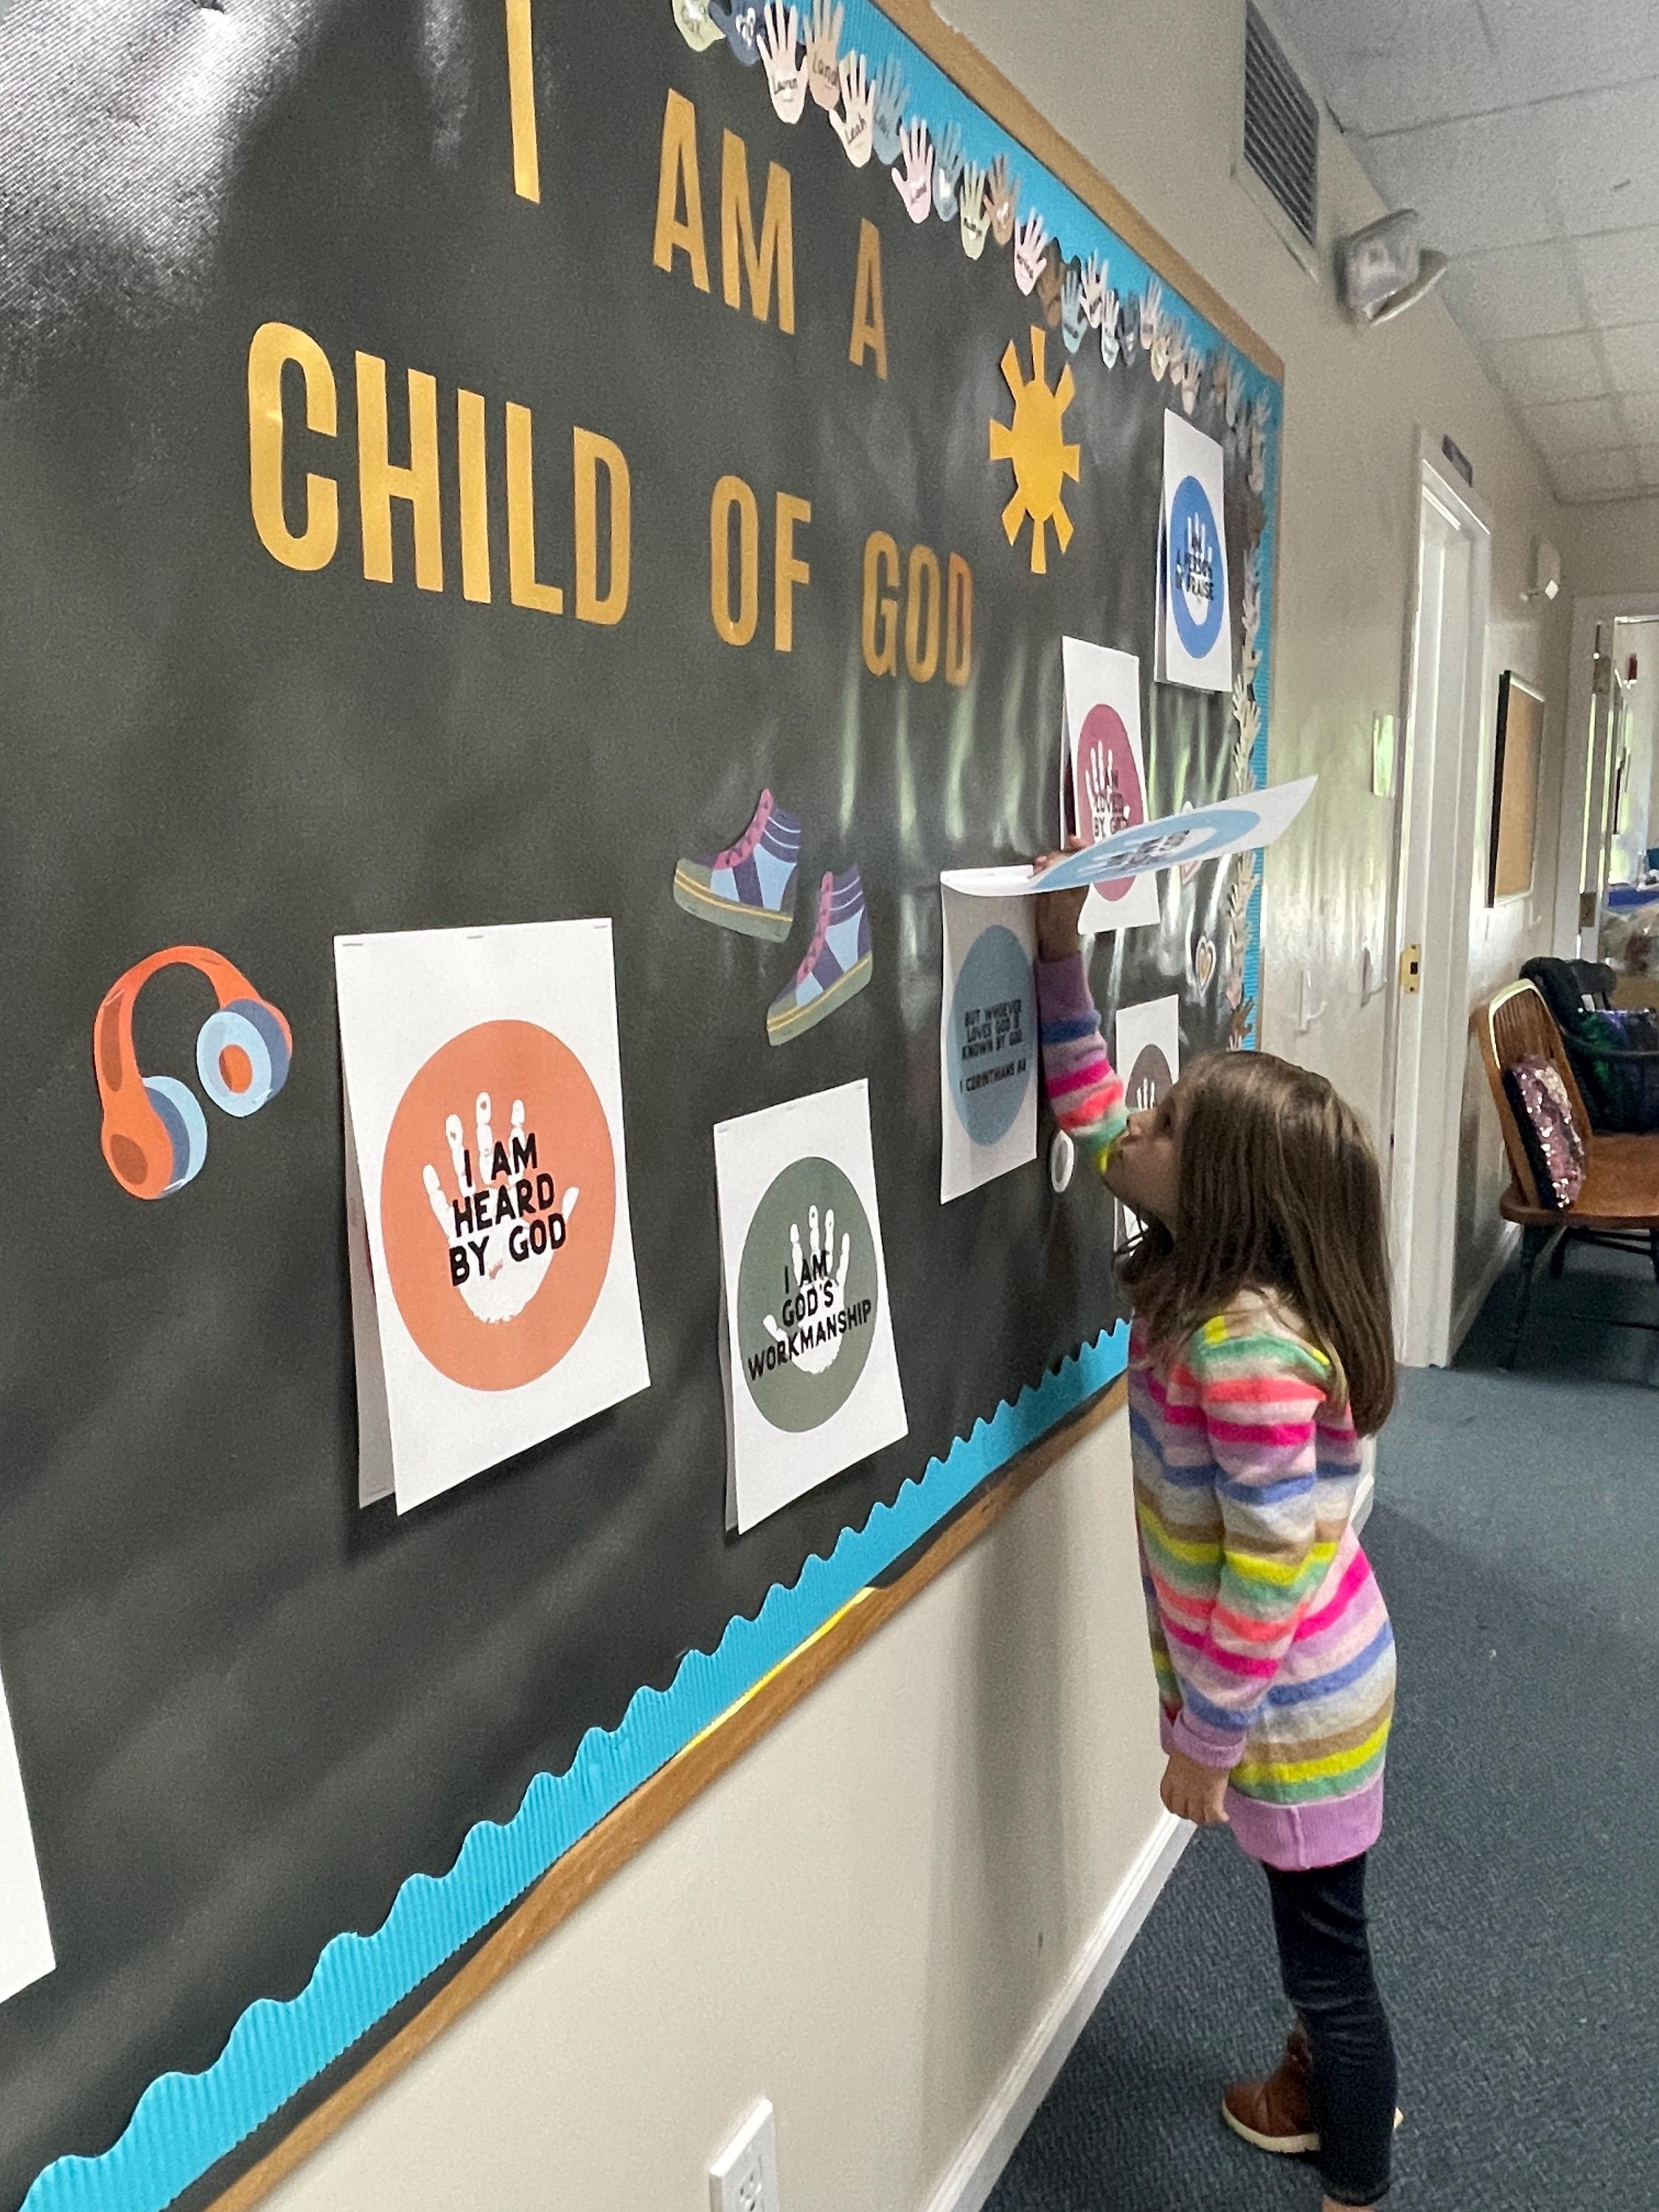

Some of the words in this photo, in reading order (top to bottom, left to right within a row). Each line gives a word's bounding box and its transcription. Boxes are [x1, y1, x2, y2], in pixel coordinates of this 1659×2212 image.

[506, 0, 540, 204] I
[653, 88, 794, 335] AM
[849, 218, 886, 380] A
[248, 322, 630, 625] CHILD
[710, 476, 810, 652] OF
[862, 531, 973, 686] GOD
[1094, 816, 1105, 838] BY
[464, 1150, 472, 1187] I
[491, 1133, 538, 1180] AM
[453, 1173, 554, 1238] HEARD
[449, 1236, 489, 1287] BY
[509, 1213, 566, 1262] GOD
[785, 1266, 790, 1294] I
[800, 1250, 829, 1287] AM
[782, 1280, 834, 1327] GOD'S
[748, 1299, 872, 1380] WORKMANSHIP
